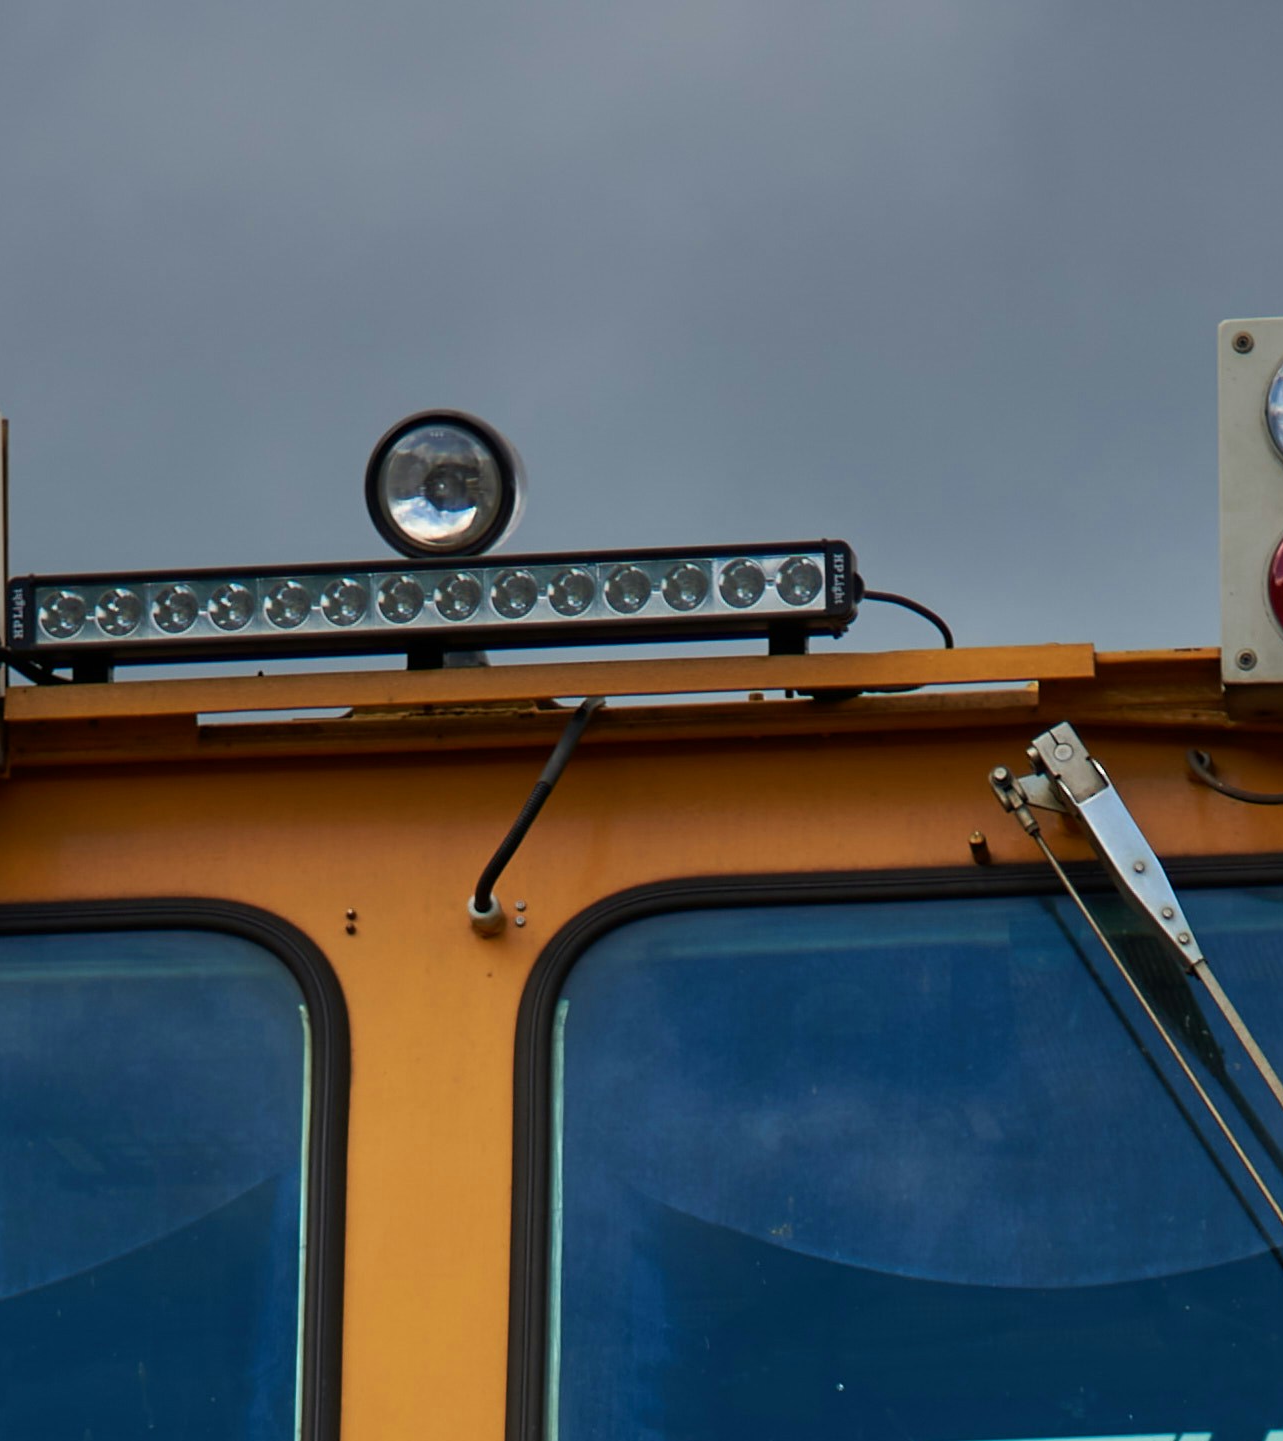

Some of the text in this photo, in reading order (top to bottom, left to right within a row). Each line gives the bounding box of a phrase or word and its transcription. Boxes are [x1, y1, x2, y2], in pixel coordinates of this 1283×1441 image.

[830, 553, 845, 604] HP Light
[12, 588, 26, 639] HP Light
